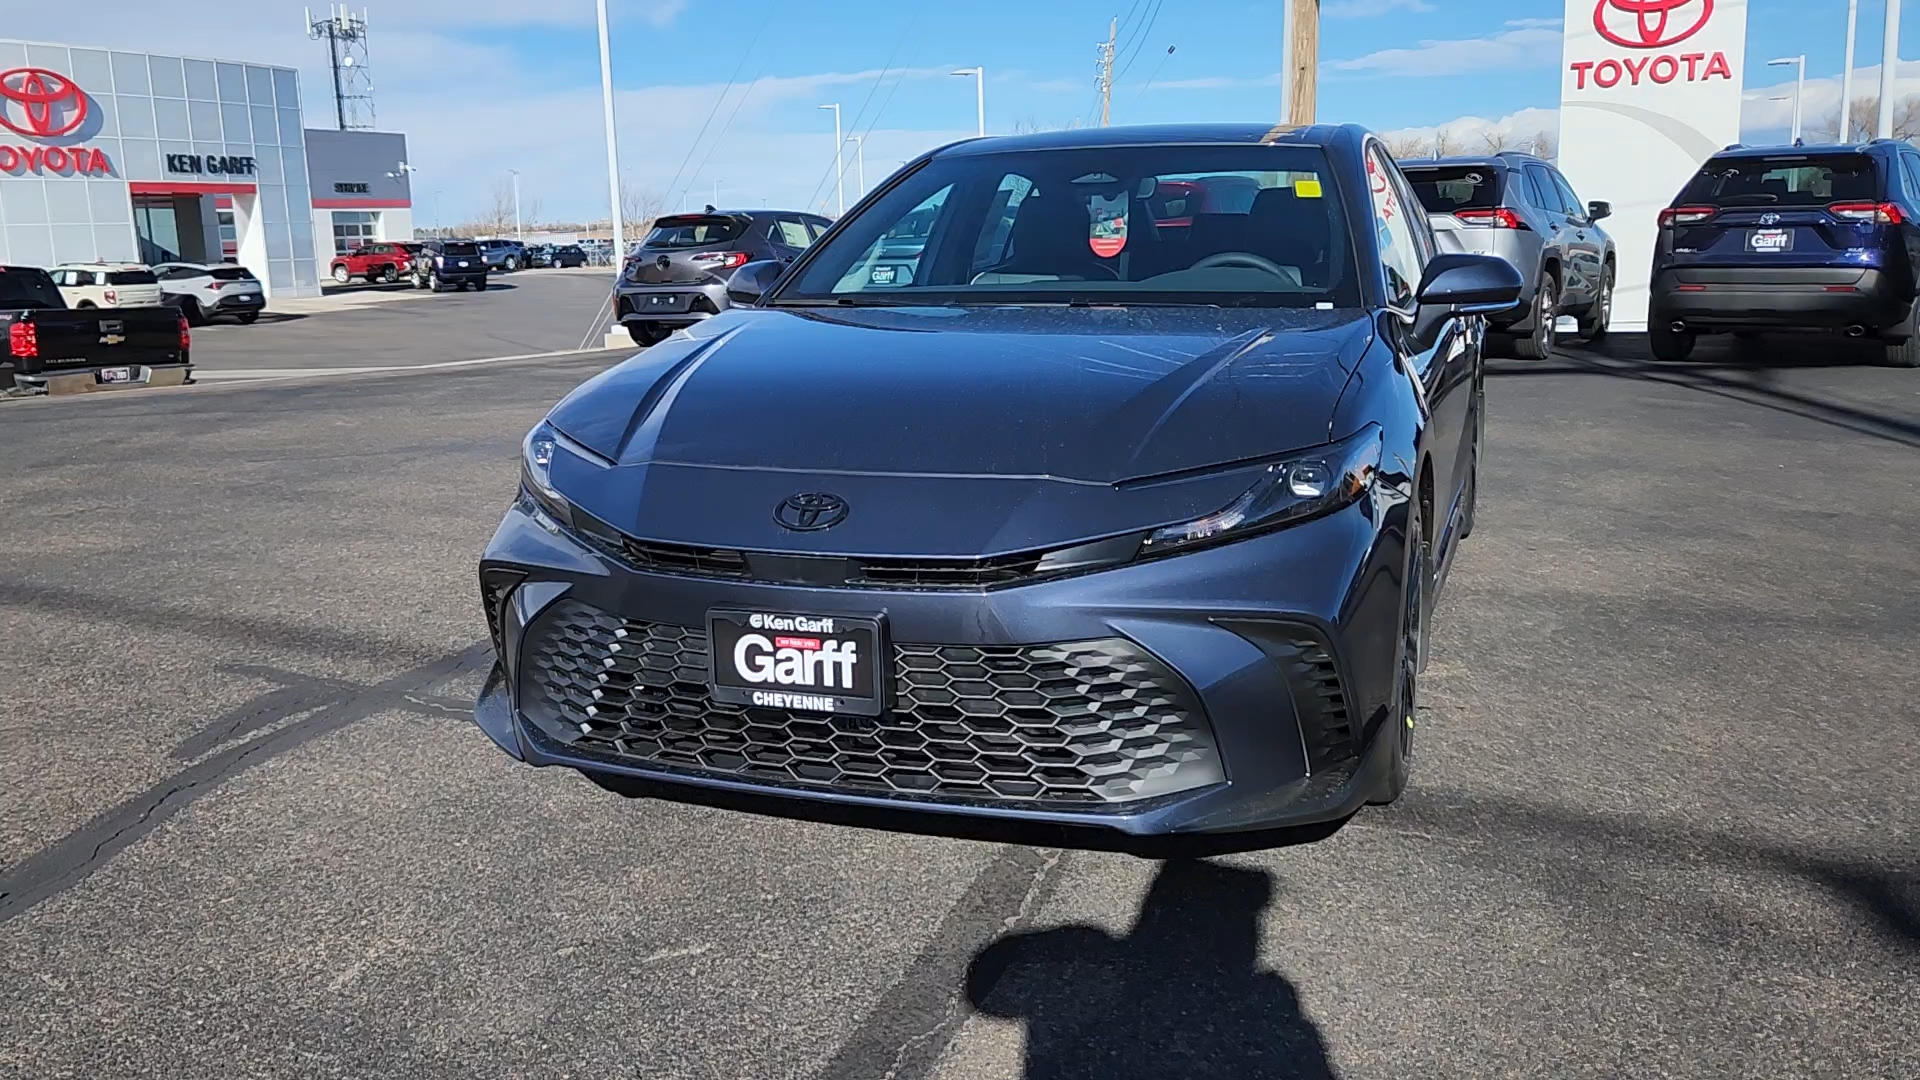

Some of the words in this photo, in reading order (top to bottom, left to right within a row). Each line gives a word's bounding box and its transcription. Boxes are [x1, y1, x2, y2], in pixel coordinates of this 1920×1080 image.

[1570, 51, 1732, 90] TOYOTA
[0, 145, 111, 173] OYOTA
[166, 153, 202, 173] KEN
[206, 155, 256, 174] GARFF
[1751, 234, 1788, 247] Garff
[734, 633, 857, 689] Garff
[752, 692, 835, 711] CHEYENNE
